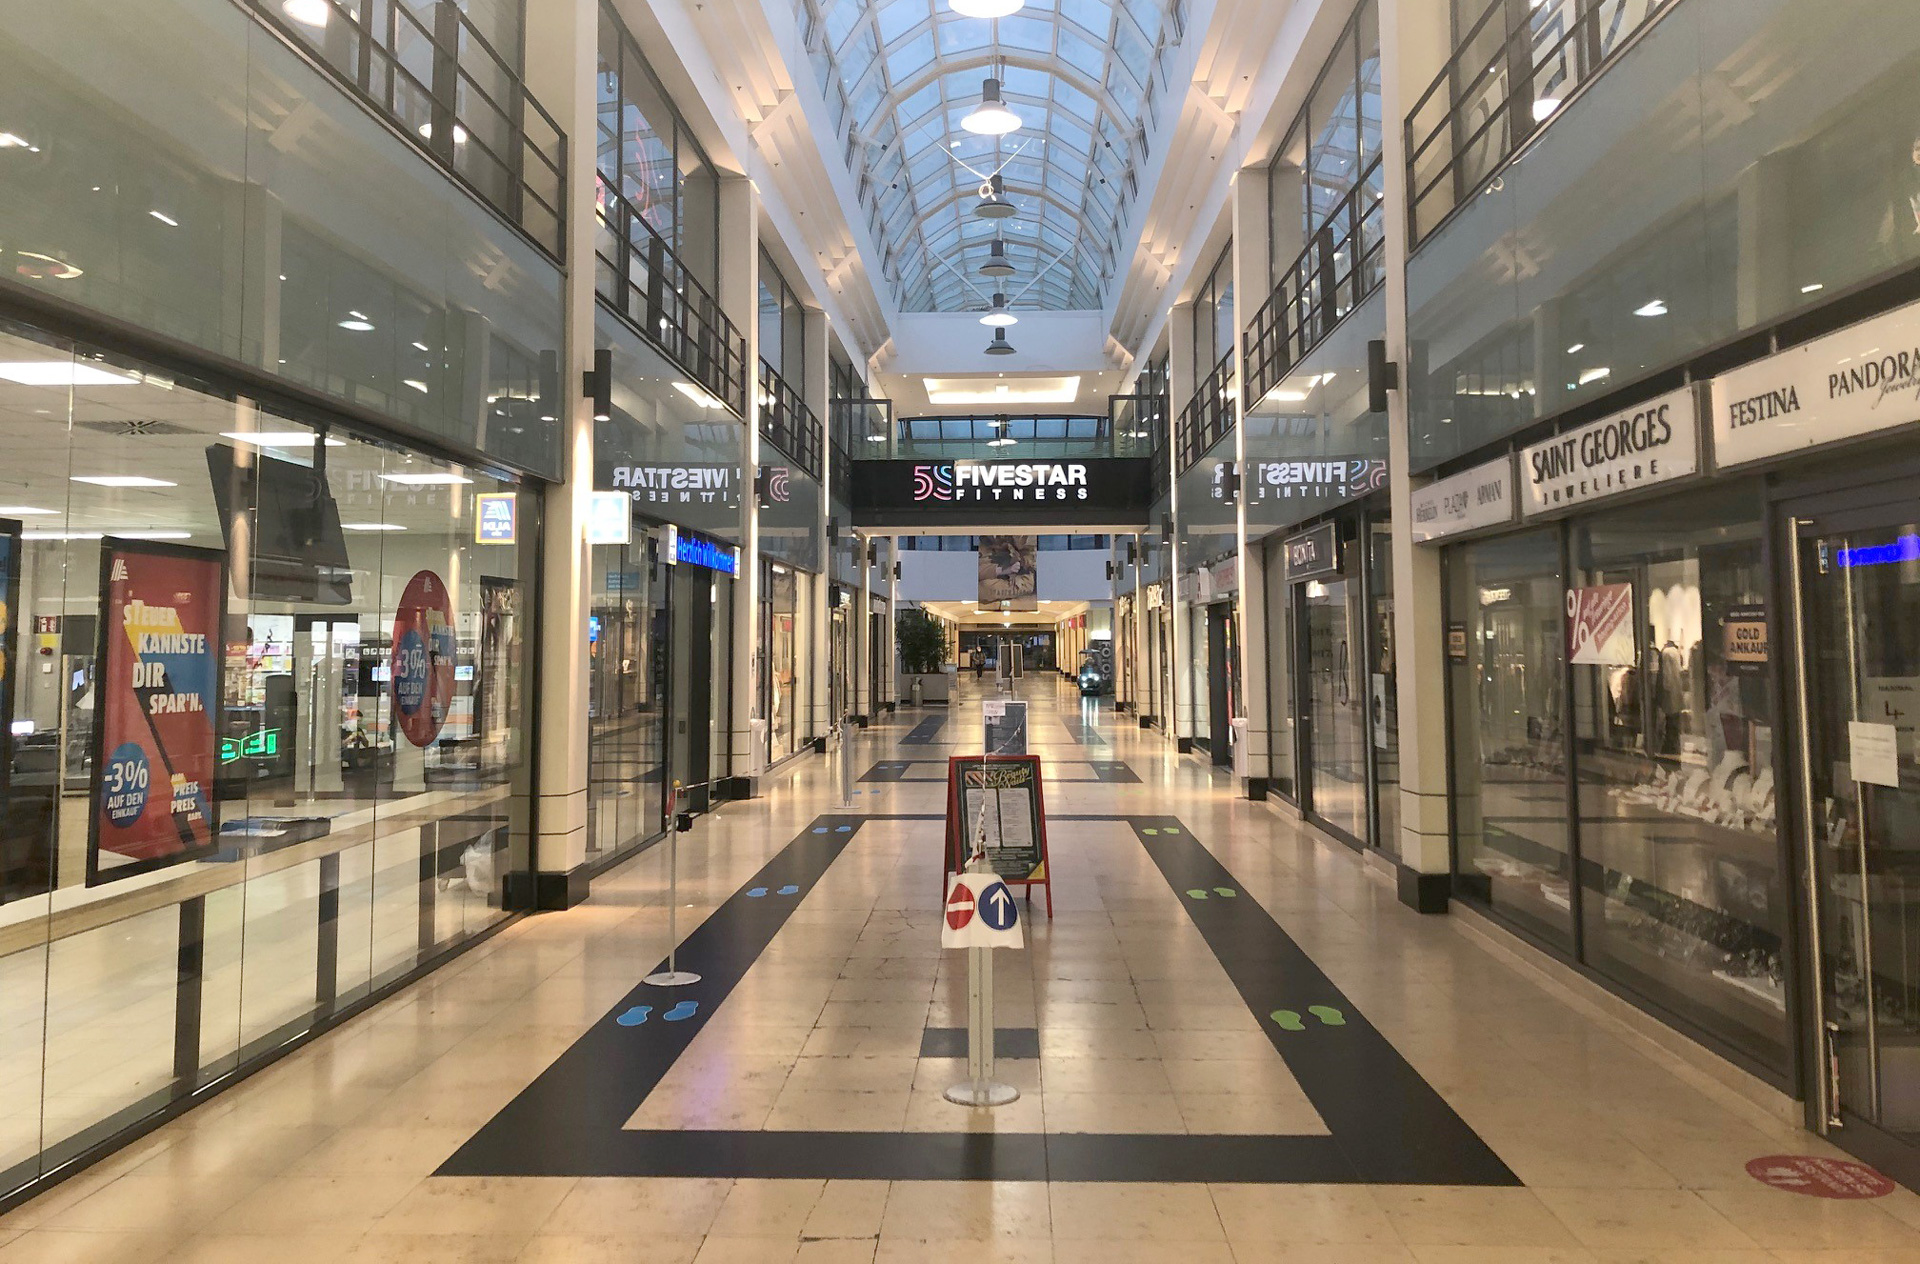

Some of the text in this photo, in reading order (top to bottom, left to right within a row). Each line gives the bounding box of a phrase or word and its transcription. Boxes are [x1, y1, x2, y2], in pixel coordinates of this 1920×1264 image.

[1729, 386, 1800, 429] FESTINA
[1532, 404, 1671, 485] SAINT GEORGES
[955, 464, 1087, 486] FIVESTAR
[1543, 459, 1658, 506] JUWELIERE
[956, 488, 1088, 500] FITNESS
[138, 633, 205, 654] KANNSTE
[1736, 627, 1760, 640] GOLD
[132, 662, 165, 688] DIR
[149, 692, 203, 715] SPAR'N.
[104, 759, 147, 793] -3%
[993, 767, 1030, 787] Beauty
[173, 781, 199, 797] PREIS
[107, 792, 143, 810] AUF DEN
[170, 797, 196, 814] PREIS
[112, 805, 140, 819] EINKAUF
